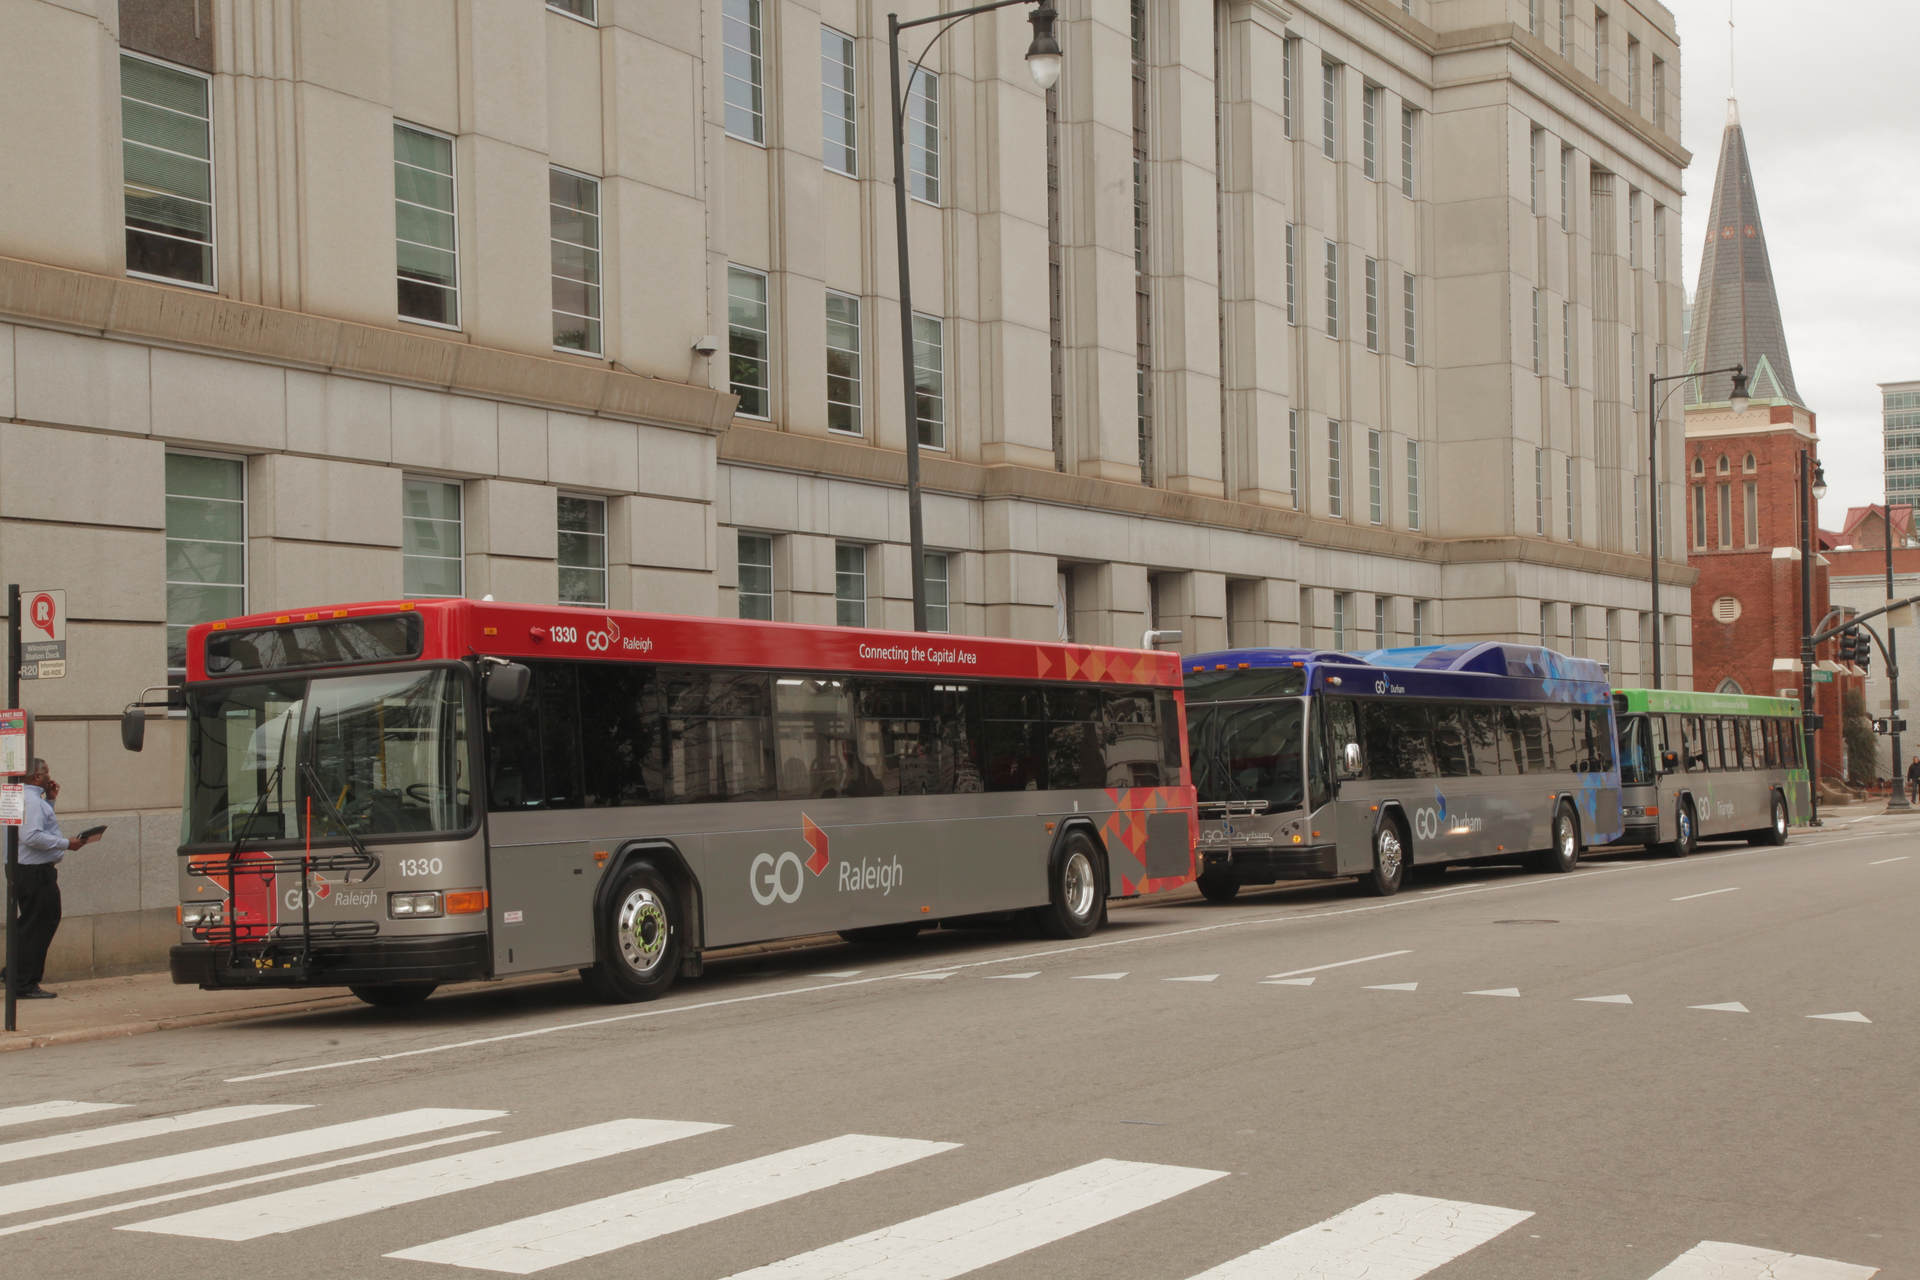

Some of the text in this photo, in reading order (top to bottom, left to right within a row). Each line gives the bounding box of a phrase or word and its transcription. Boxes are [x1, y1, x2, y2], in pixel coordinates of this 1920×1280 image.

[37, 602, 49, 621] R
[550, 626, 577, 643] 1330
[586, 630, 653, 653] GO Raleigh
[25, 651, 60, 661] Station Deck
[27, 644, 58, 653] Wilmington
[859, 643, 976, 665] Connecting the Capital Area
[21, 665, 38, 676] R20
[1375, 680, 1406, 694] GO Durham
[1698, 796, 1734, 821] GO Triangle
[1415, 807, 1482, 840] GO Durham
[1237, 831, 1270, 839] Durham
[399, 858, 443, 876] 1330
[750, 851, 903, 906] GO Raleigh
[285, 889, 378, 910] GO Raleigh
